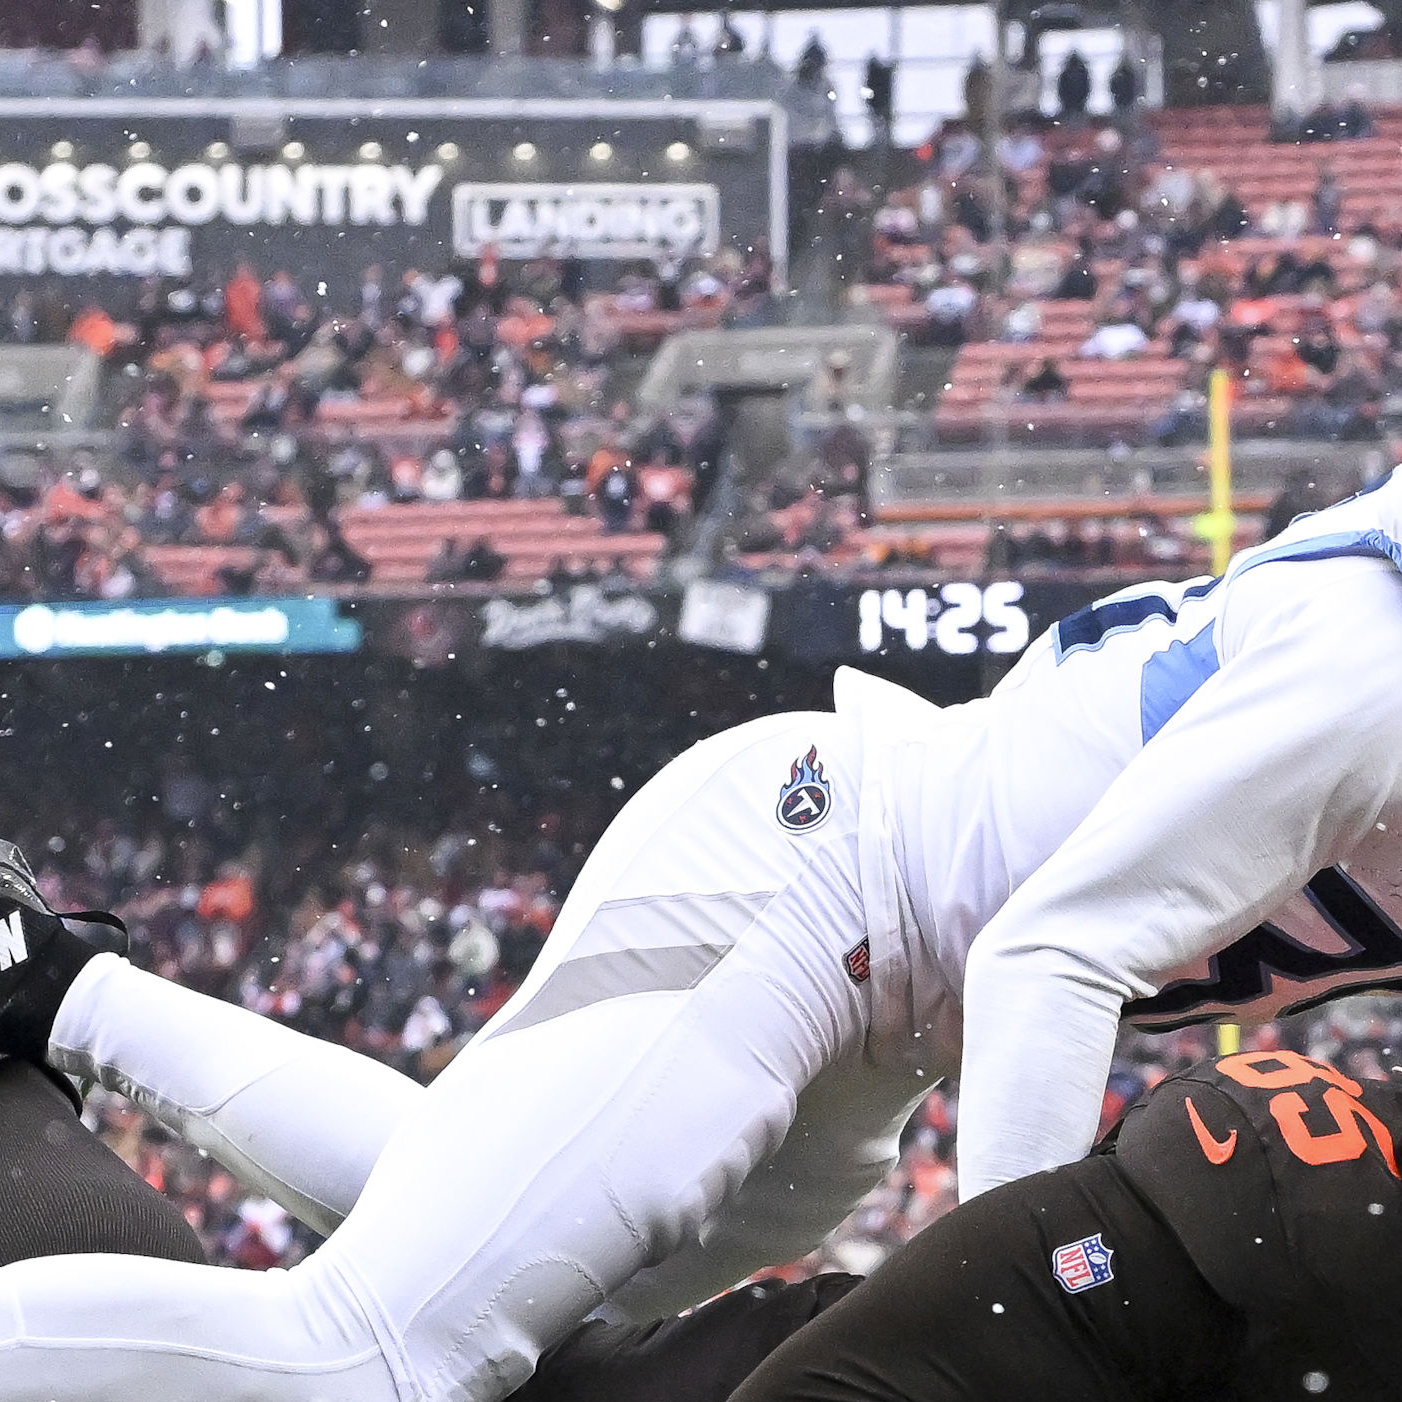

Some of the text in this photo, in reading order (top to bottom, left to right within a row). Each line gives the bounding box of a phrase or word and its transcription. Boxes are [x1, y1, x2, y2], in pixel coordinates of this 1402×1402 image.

[470, 199, 702, 242] LANDING
[1215, 1049, 1402, 1180] 85
[1060, 1246, 1095, 1288] NFL
